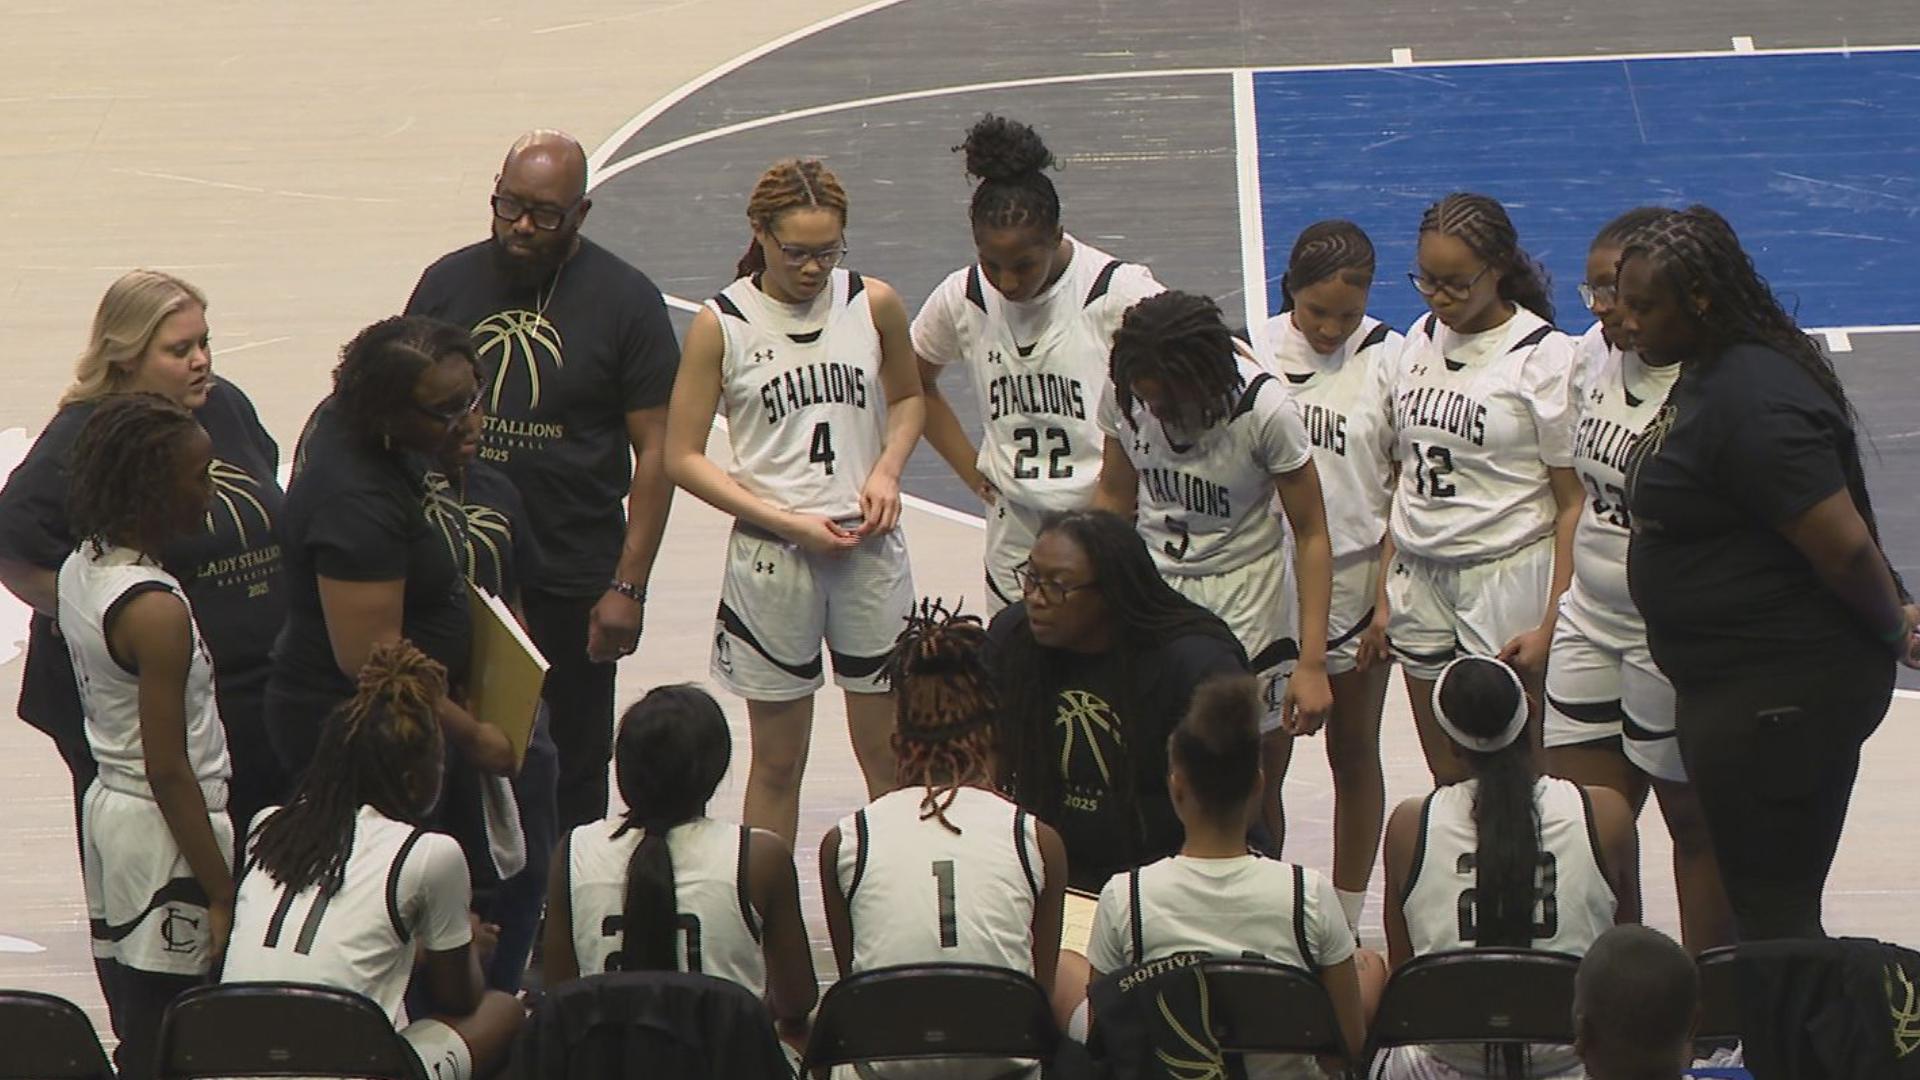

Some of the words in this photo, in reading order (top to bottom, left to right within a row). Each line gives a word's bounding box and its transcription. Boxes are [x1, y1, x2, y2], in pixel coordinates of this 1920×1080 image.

[760, 362, 866, 425] STALLIONS
[989, 373, 1086, 421] STALLIONS
[481, 415, 564, 438] STALLIONS
[809, 421, 835, 475] 4
[1574, 418, 1638, 474] STALLIO
[479, 446, 509, 462] 2025
[1013, 427, 1074, 479] 22
[1412, 442, 1456, 498] 12
[1141, 467, 1231, 518] TALLIONS
[197, 556, 238, 577] LADY
[1064, 793, 1098, 812] 2025
[262, 882, 336, 956] 11
[931, 860, 958, 948] 1
